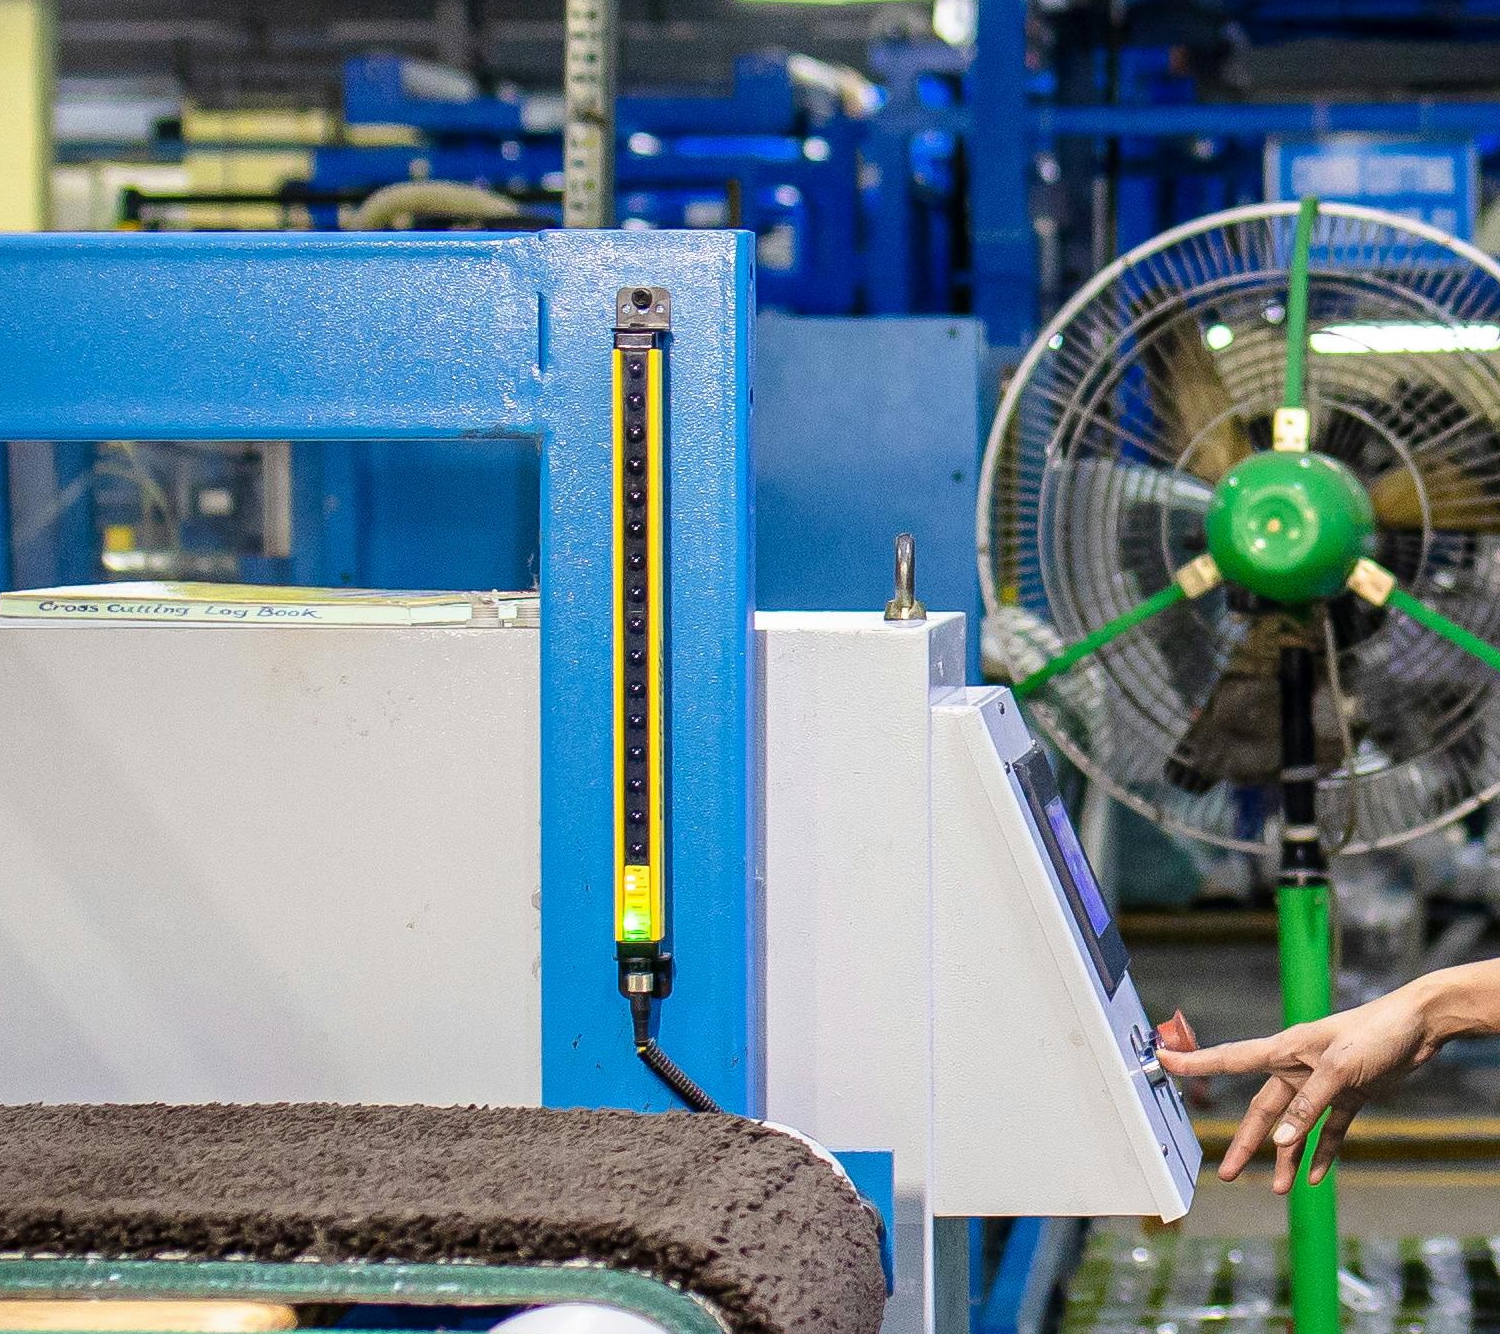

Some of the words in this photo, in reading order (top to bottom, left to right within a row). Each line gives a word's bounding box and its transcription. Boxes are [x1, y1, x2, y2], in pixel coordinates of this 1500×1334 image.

[39, 600, 99, 614] Cross
[107, 603, 190, 617] Cutting
[256, 605, 323, 618] Book
